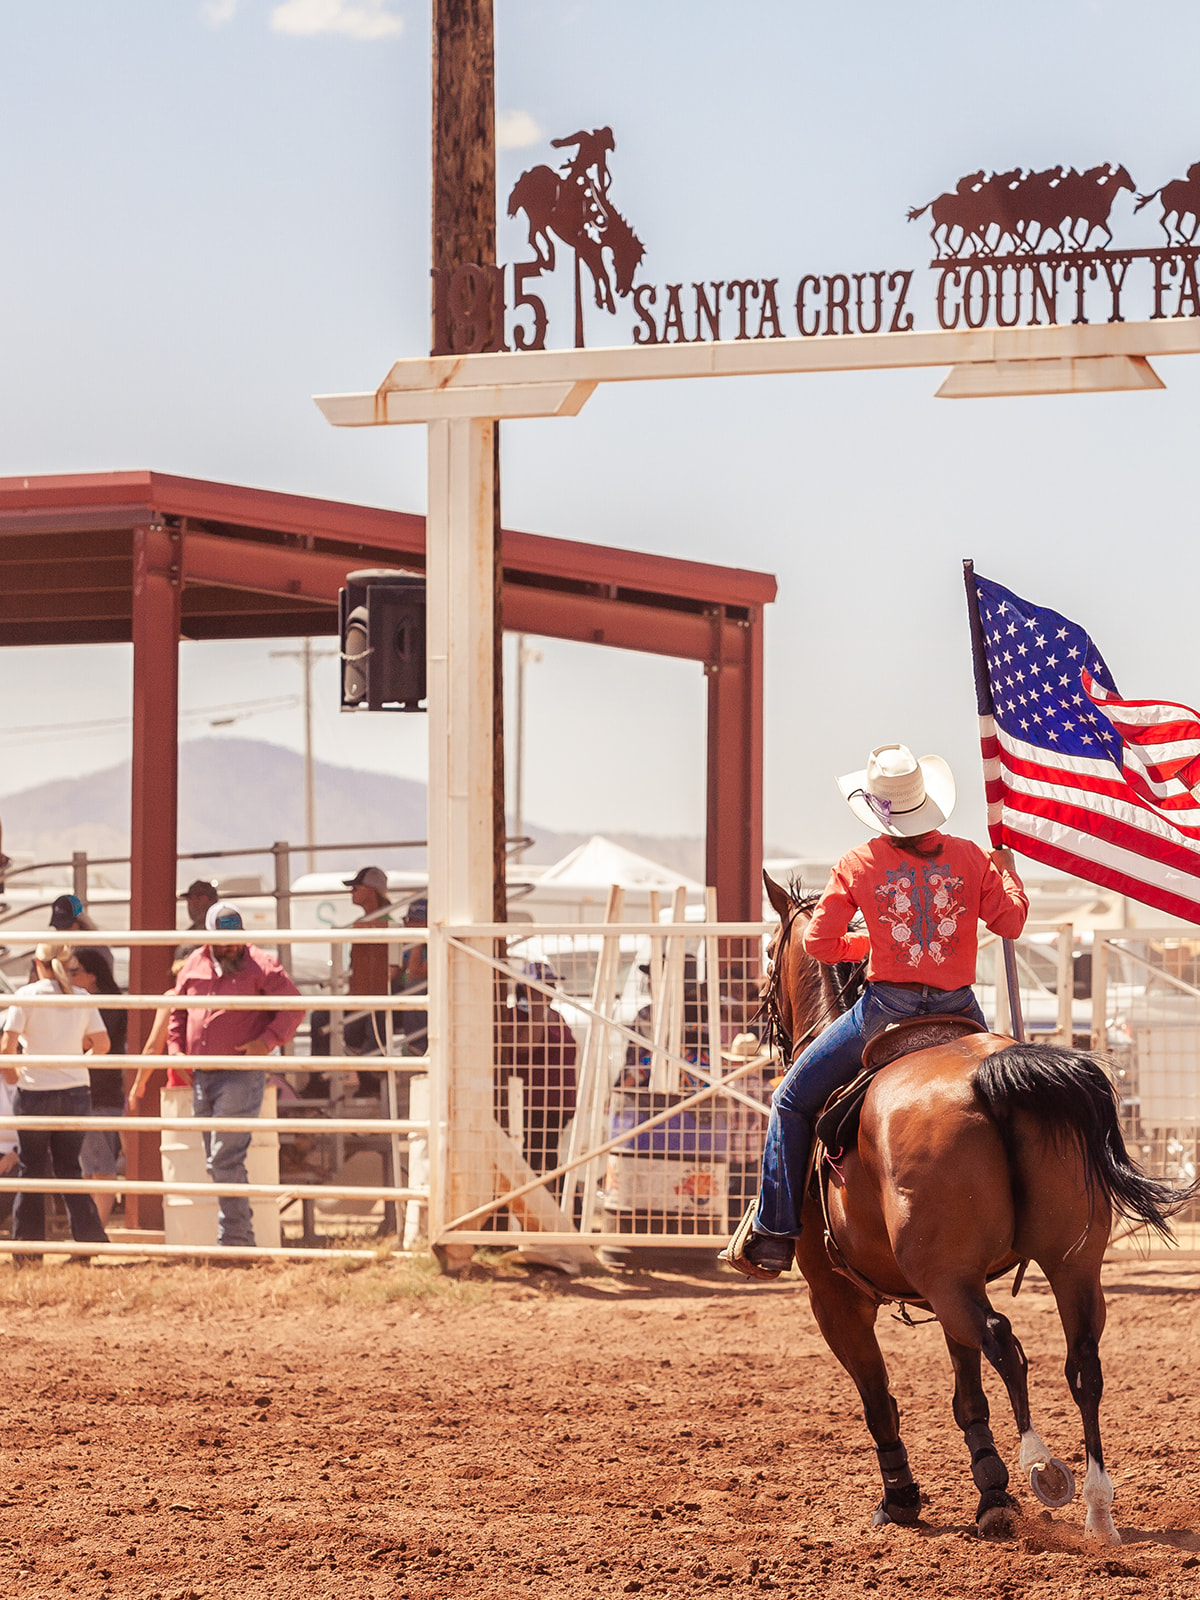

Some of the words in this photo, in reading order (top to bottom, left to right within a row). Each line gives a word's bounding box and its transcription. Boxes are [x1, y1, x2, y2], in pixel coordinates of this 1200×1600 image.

[633, 278, 786, 345] SANTA
[795, 269, 914, 338] CRUZ
[935, 256, 1125, 329] COUNTY
